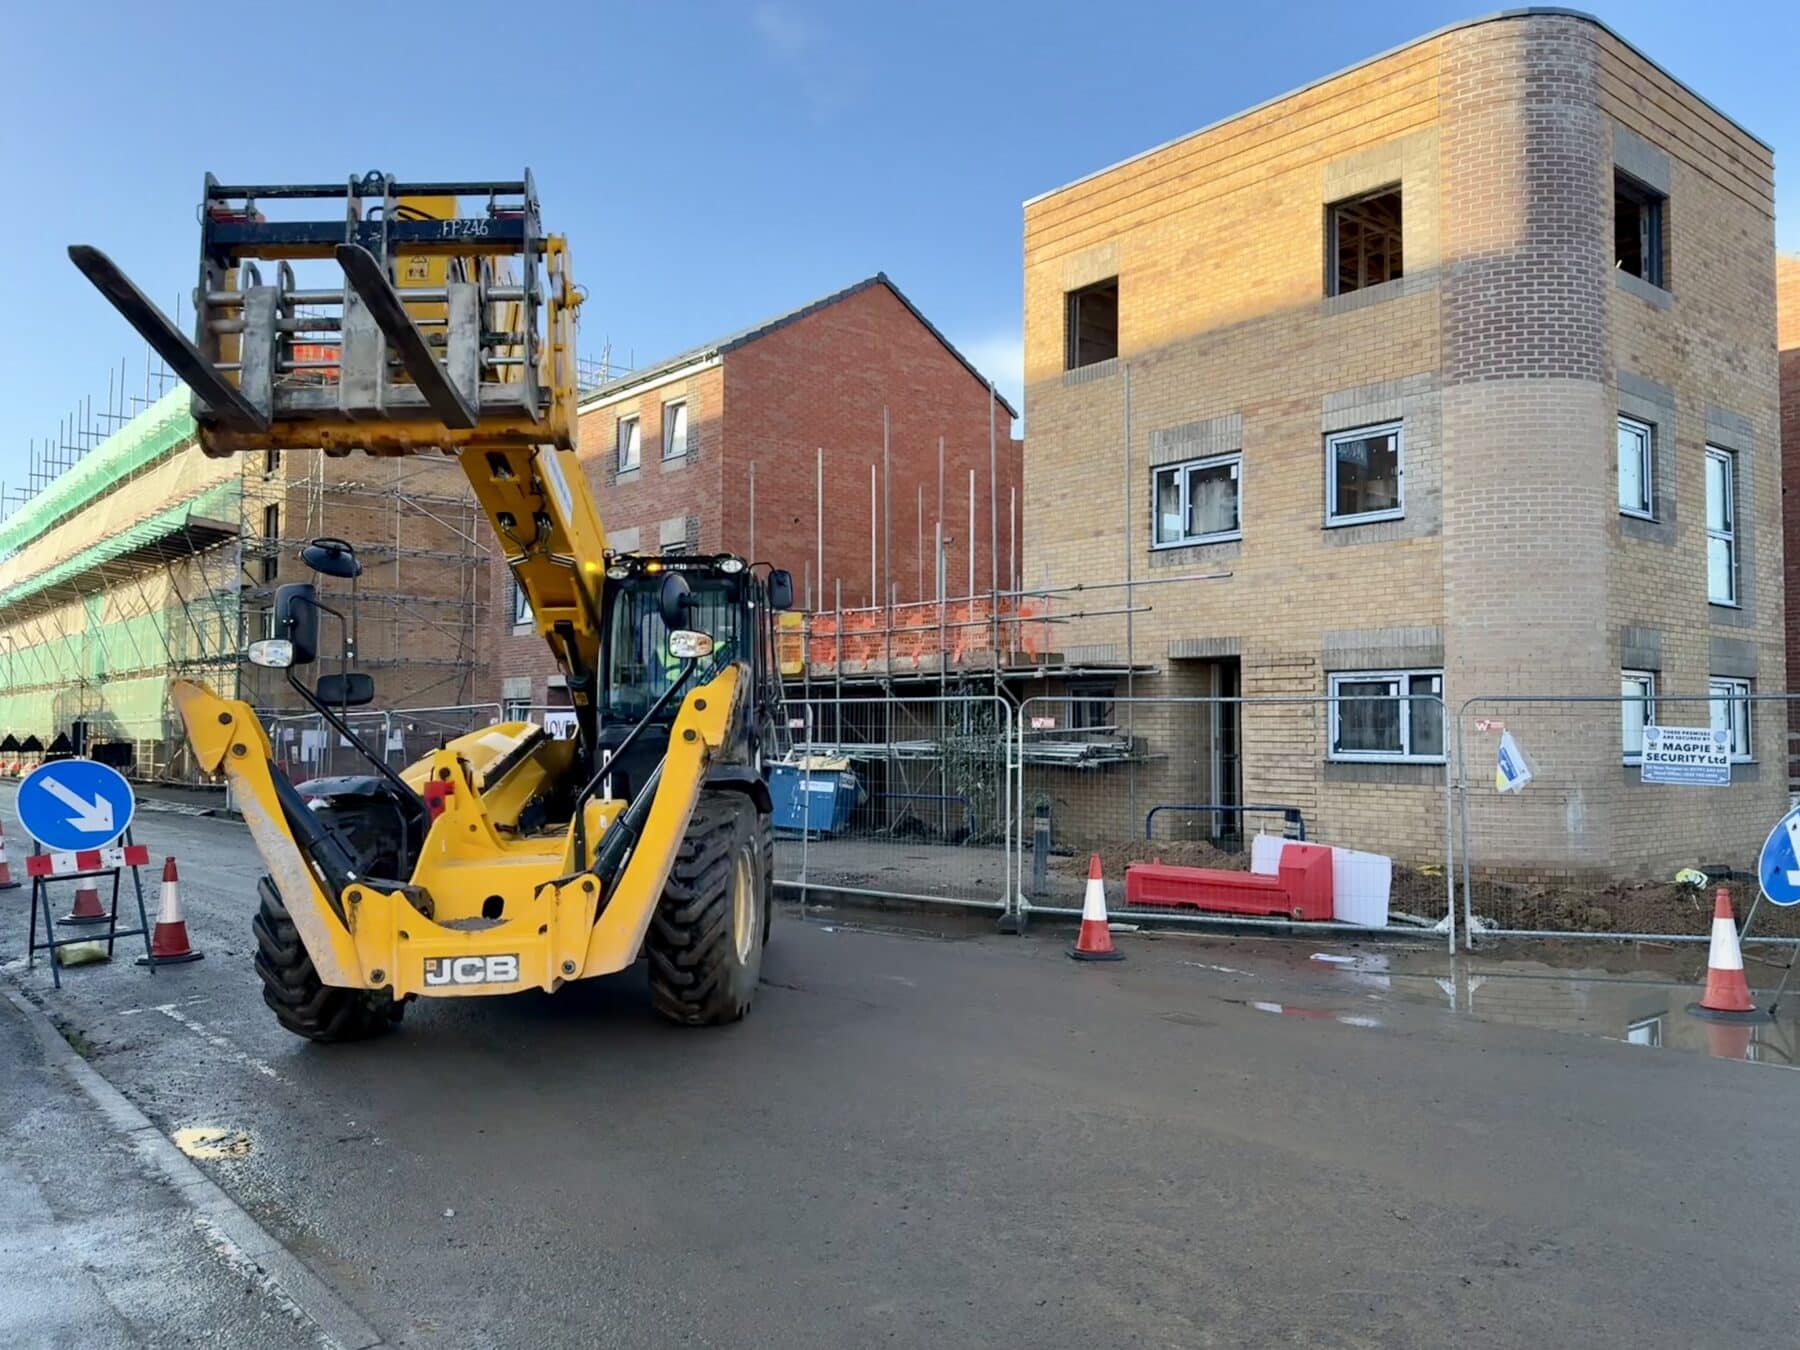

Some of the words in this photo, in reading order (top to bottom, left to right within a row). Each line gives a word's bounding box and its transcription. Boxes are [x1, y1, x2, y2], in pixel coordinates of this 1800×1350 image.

[1663, 742, 1711, 753] MAGPIE
[1646, 752, 1706, 764] SECURITY
[1708, 755, 1727, 765] Ltd
[425, 956, 518, 985] JCB
